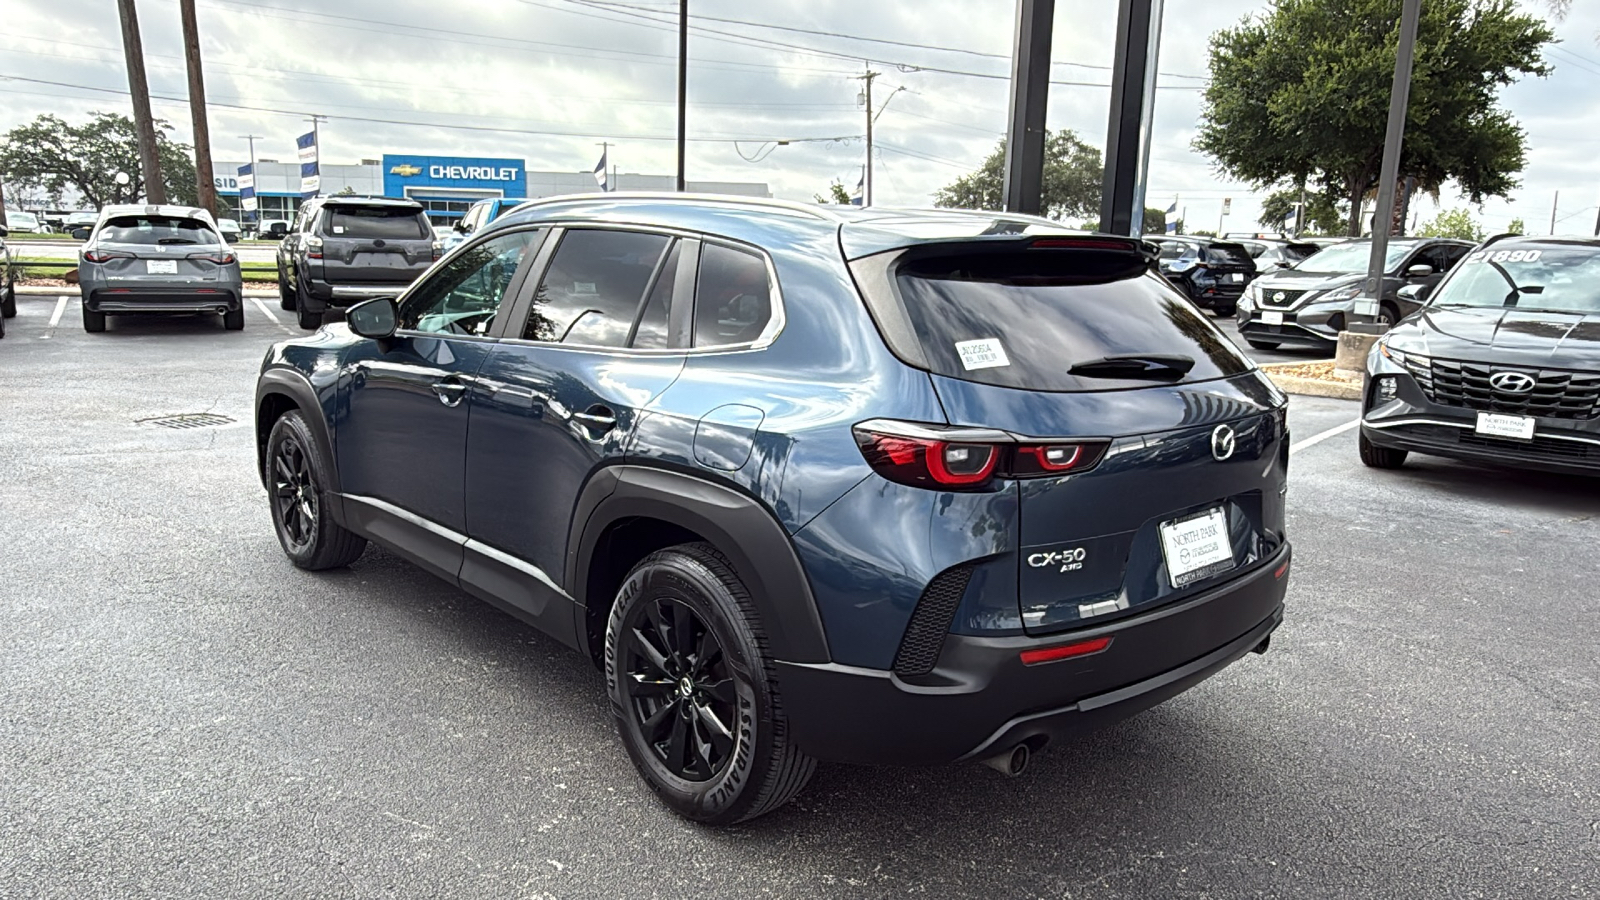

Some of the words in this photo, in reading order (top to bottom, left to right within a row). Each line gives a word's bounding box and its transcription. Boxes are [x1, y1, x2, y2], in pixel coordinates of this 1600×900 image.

[429, 165, 519, 181] CHEVROLET
[1466, 249, 1542, 264] 21890
[1484, 417, 1508, 425] NORTH
[1509, 420, 1527, 428] PARK
[1172, 529, 1200, 547] NORTH
[1199, 523, 1219, 539] PARK
[1027, 547, 1087, 569] CX-50
[1060, 562, 1083, 573] AWD
[1175, 569, 1197, 584] NORTH
[1196, 564, 1211, 577] PARK
[708, 693, 752, 805] ASSURANCE
